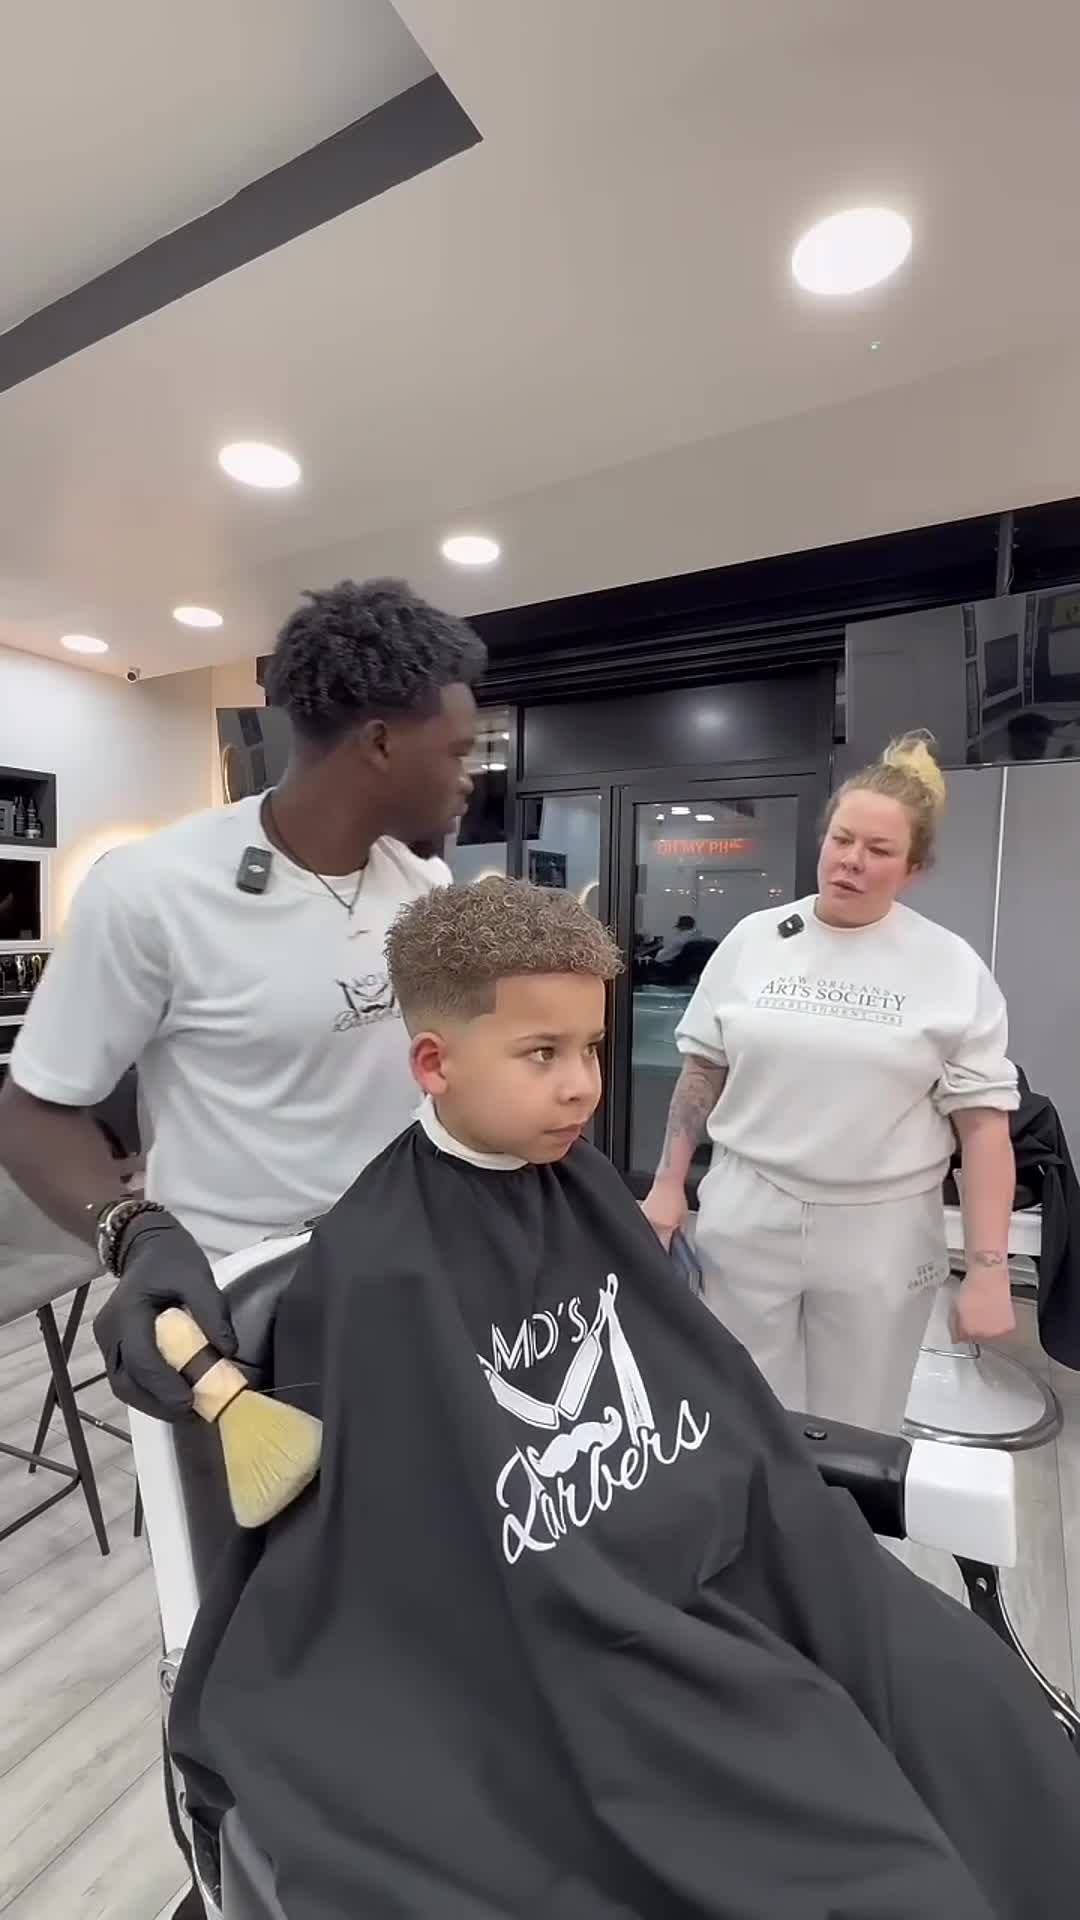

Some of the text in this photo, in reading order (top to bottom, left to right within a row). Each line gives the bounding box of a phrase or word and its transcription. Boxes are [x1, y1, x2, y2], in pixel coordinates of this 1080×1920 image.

[760, 979, 907, 1012] ARTS SOCIETY
[777, 975, 892, 997] NEW ORLEANS
[491, 1296, 588, 1372] MD'S
